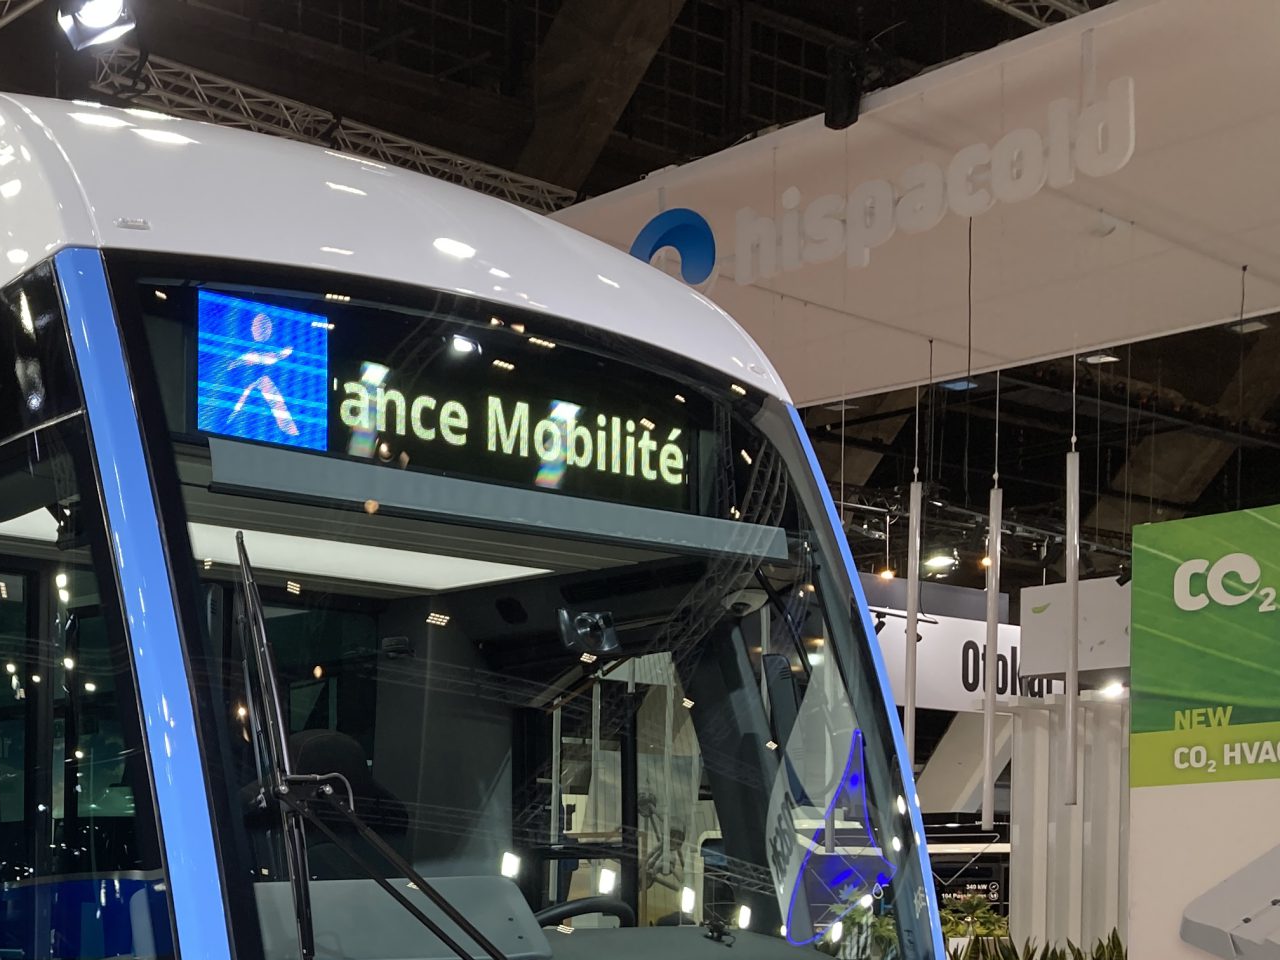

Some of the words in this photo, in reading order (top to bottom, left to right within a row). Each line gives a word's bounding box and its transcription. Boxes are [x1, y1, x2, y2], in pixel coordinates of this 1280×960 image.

[734, 74, 1135, 285] hispacold
[334, 377, 469, 446] ance
[486, 396, 688, 485] Mobilité
[1174, 706, 1233, 731] NEW
